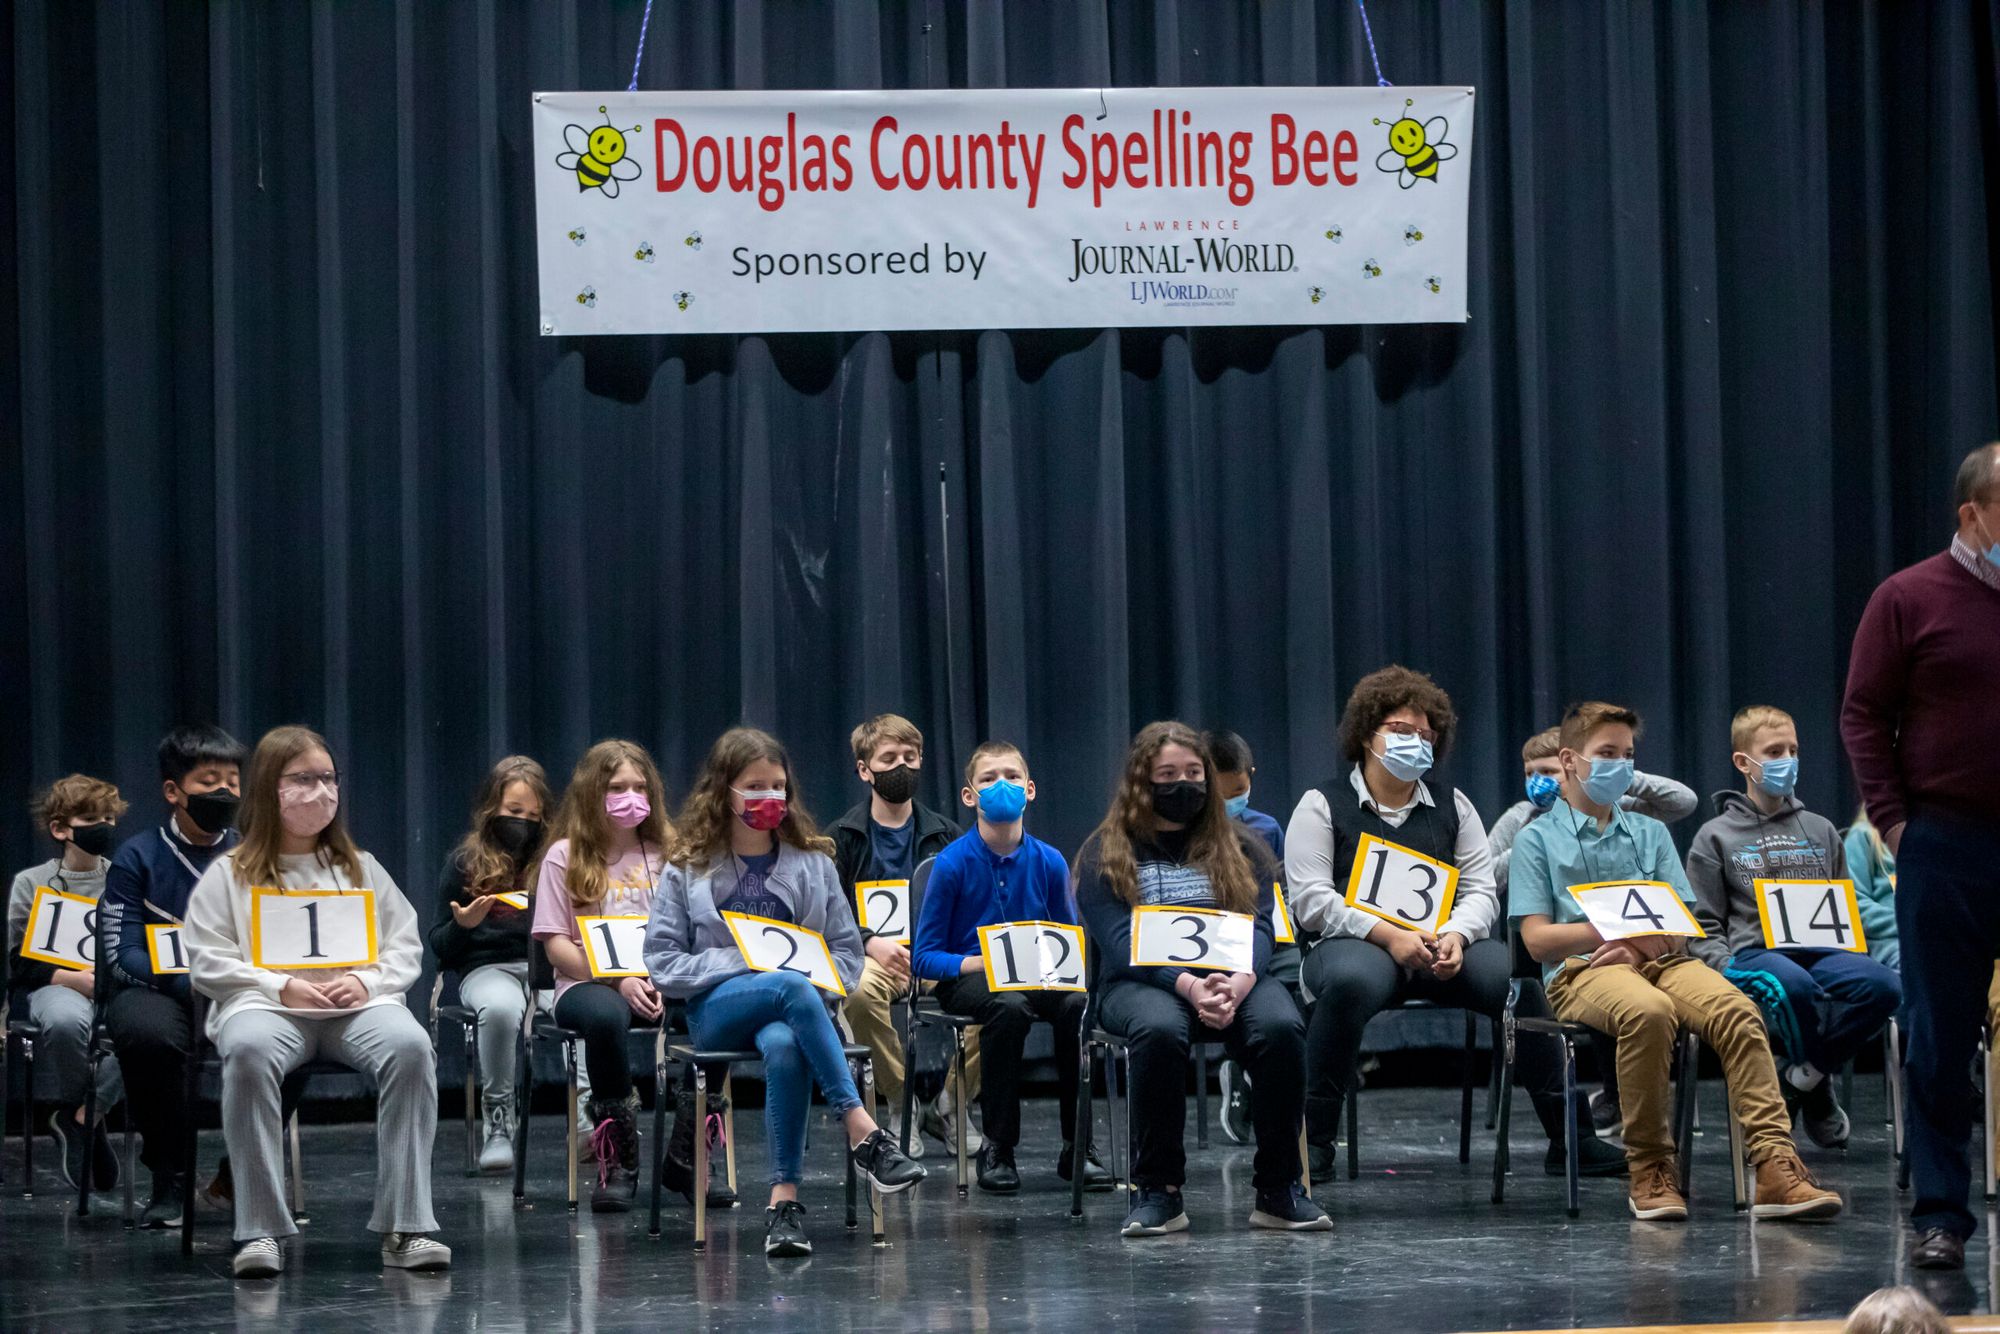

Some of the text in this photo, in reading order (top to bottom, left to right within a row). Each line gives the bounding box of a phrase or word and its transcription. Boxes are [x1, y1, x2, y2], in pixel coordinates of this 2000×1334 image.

[654, 108, 1359, 212] Douglas County Spelling Bee
[1125, 219, 1239, 231] LAWRENCE
[732, 242, 987, 283] Sponsored by
[1767, 847, 1826, 867] STATES
[1359, 849, 1438, 922] 13
[1621, 887, 1665, 930] 4
[299, 901, 329, 958] 1
[1167, 915, 1210, 963] 3
[1767, 887, 1850, 945] 14
[762, 926, 812, 979] 2
[992, 929, 1079, 985] 12
